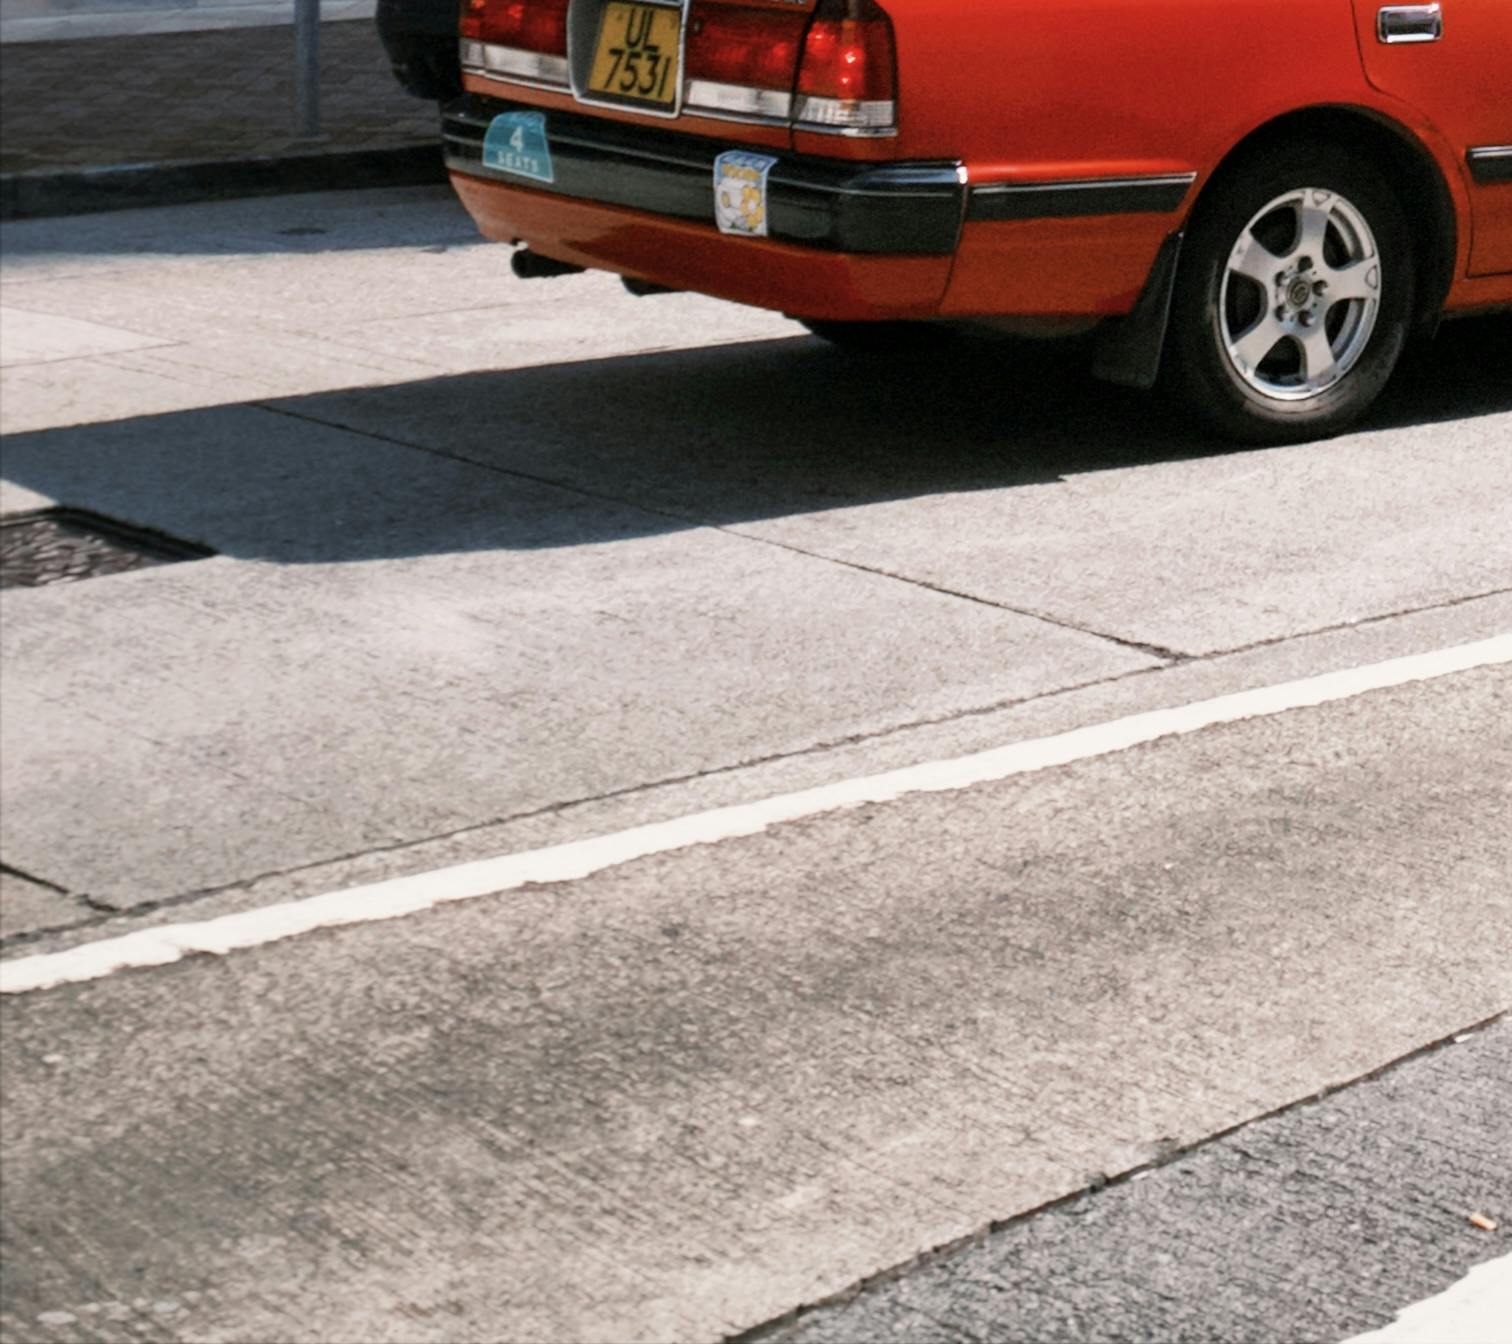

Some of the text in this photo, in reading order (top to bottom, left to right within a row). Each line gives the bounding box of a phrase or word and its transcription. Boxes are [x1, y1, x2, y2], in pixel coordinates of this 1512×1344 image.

[624, 6, 661, 54] UL
[604, 48, 673, 99] 7531
[509, 124, 524, 152] 4
[497, 150, 539, 174] SEATS
